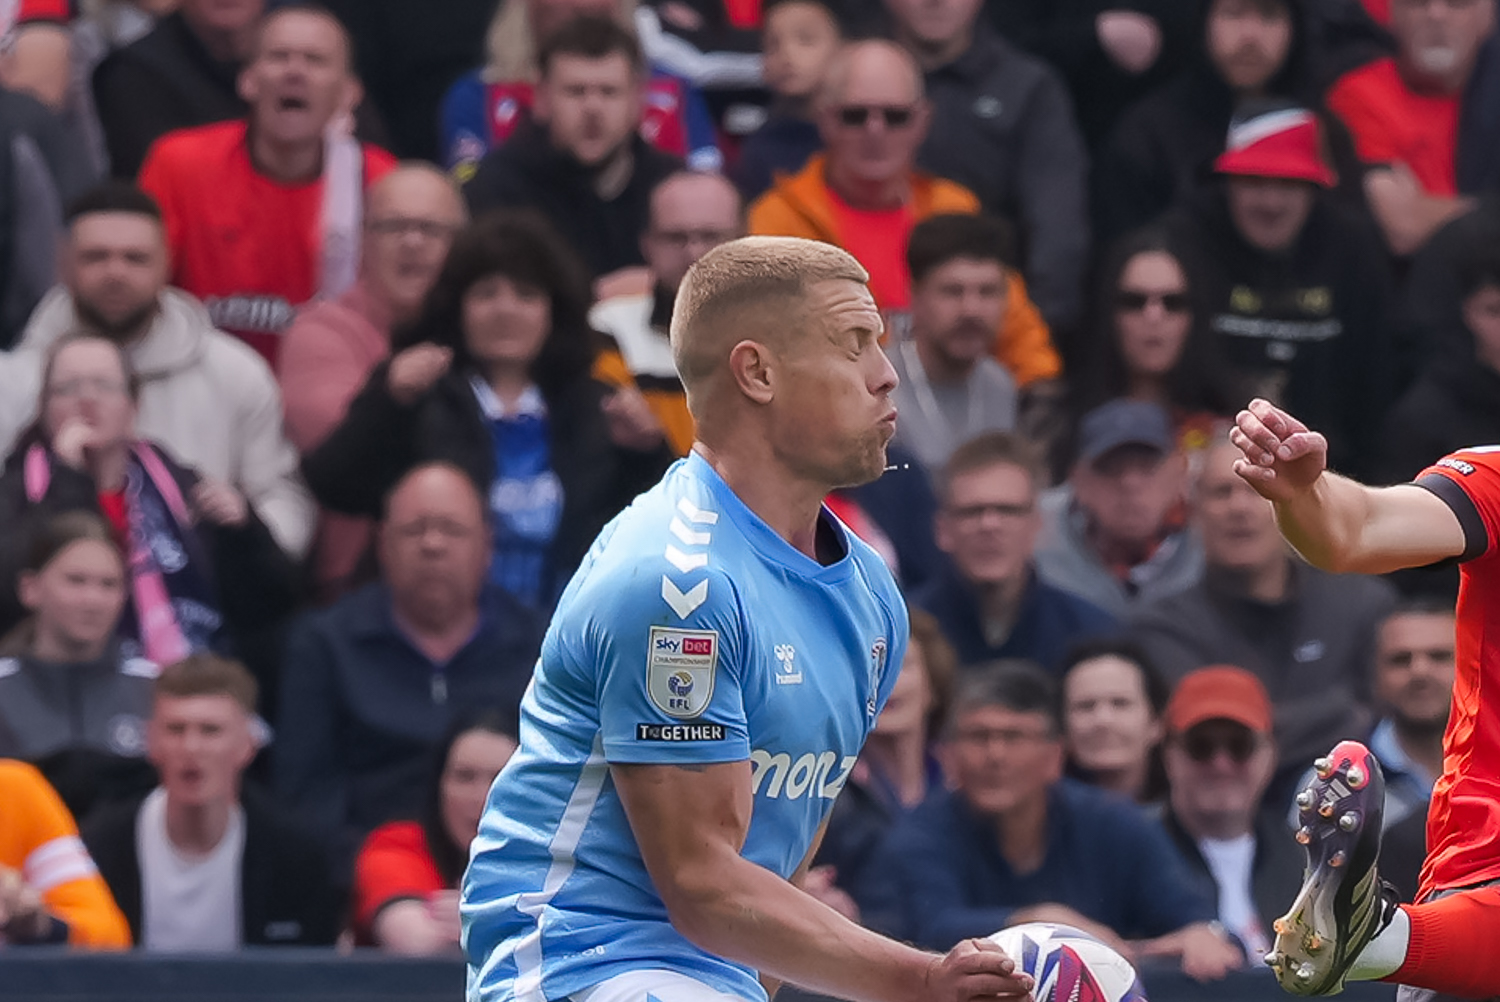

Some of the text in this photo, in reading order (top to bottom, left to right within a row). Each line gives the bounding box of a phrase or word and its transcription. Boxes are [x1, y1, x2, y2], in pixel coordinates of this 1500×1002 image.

[656, 637, 709, 653] sky bet
[669, 699, 690, 710] EFL
